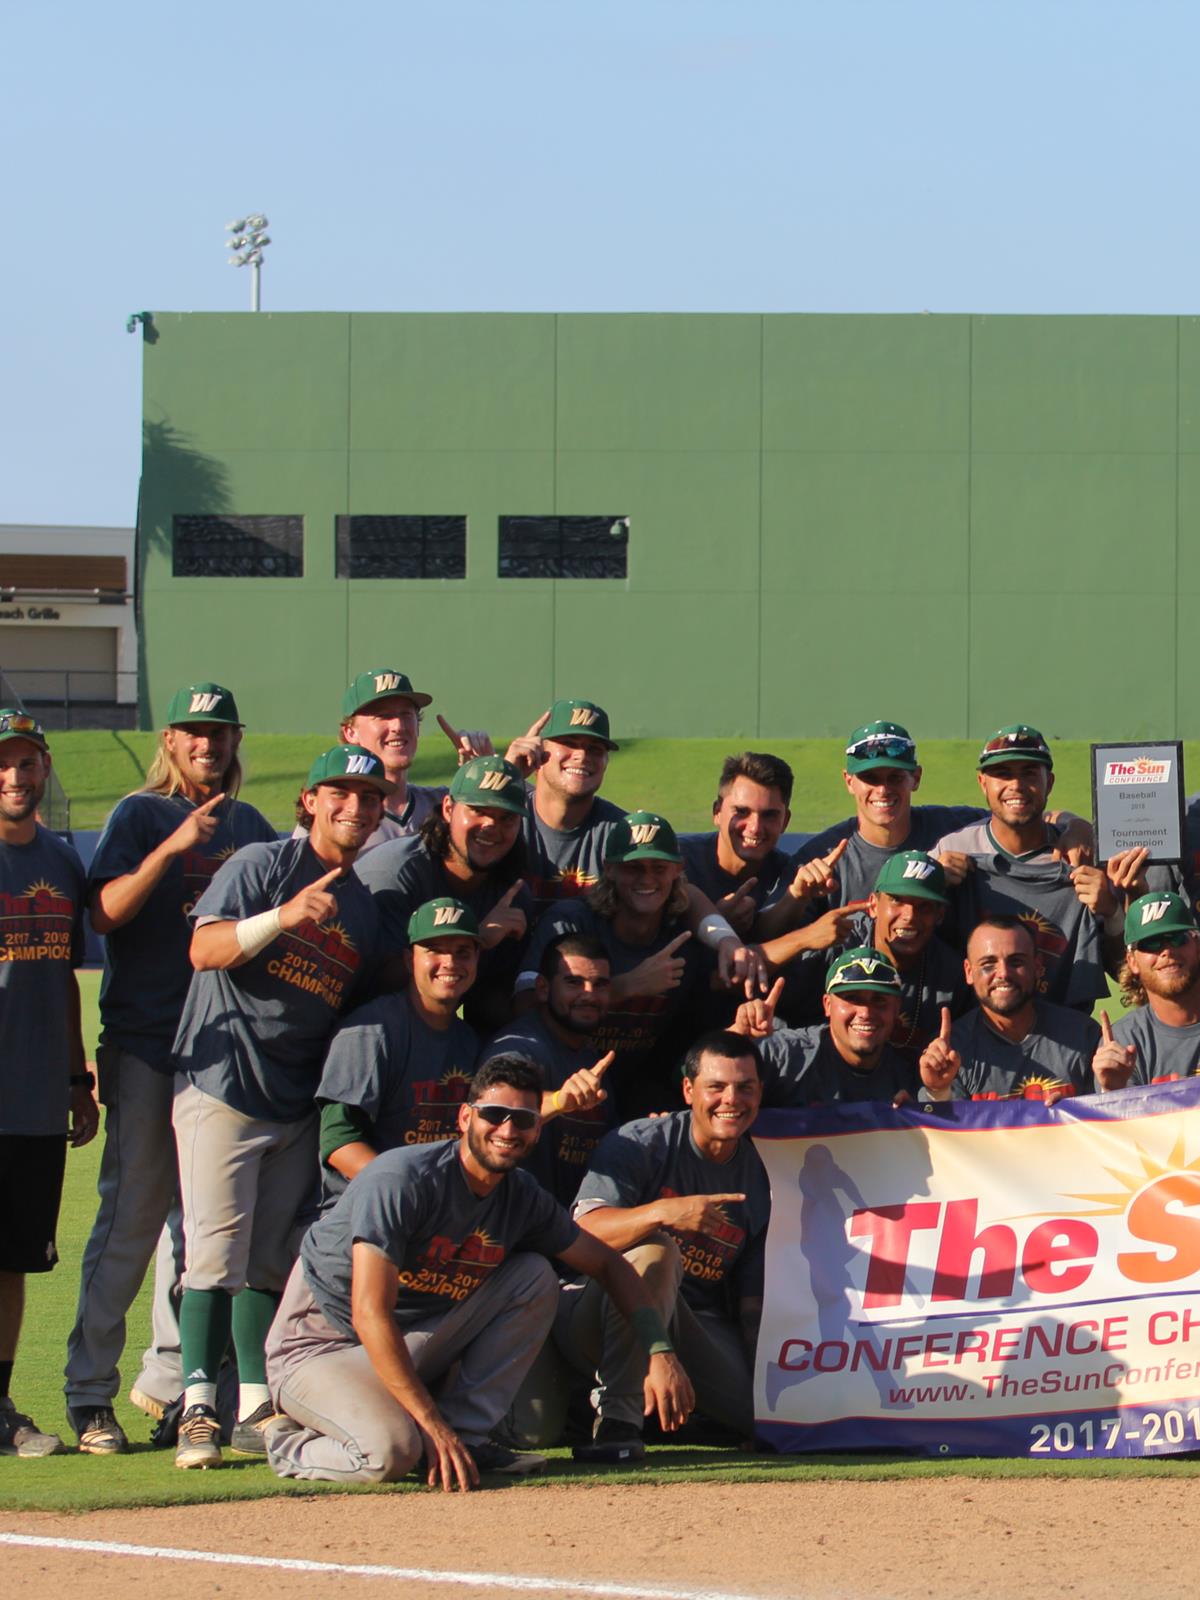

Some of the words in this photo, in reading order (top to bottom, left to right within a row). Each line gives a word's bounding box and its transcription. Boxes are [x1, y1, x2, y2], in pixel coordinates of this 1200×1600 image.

[374, 674, 402, 693] W
[189, 693, 222, 714] W
[569, 708, 599, 727] W
[345, 755, 376, 774] W
[1109, 764, 1135, 775] The
[1137, 762, 1165, 775] Sun
[479, 771, 512, 790] W
[1109, 776, 1163, 784] CONFERENCE
[1119, 791, 1156, 800] Baseball
[629, 824, 660, 844] W
[1111, 829, 1167, 838] Tournament
[1115, 839, 1163, 849] Champion
[902, 860, 936, 880] W
[433, 907, 464, 926] W
[1141, 901, 1171, 925] W
[0, 945, 71, 961] CHAMPIOS
[283, 951, 318, 975] 2017
[849, 1197, 1099, 1310] The
[778, 1316, 1129, 1373] CONFERENCE
